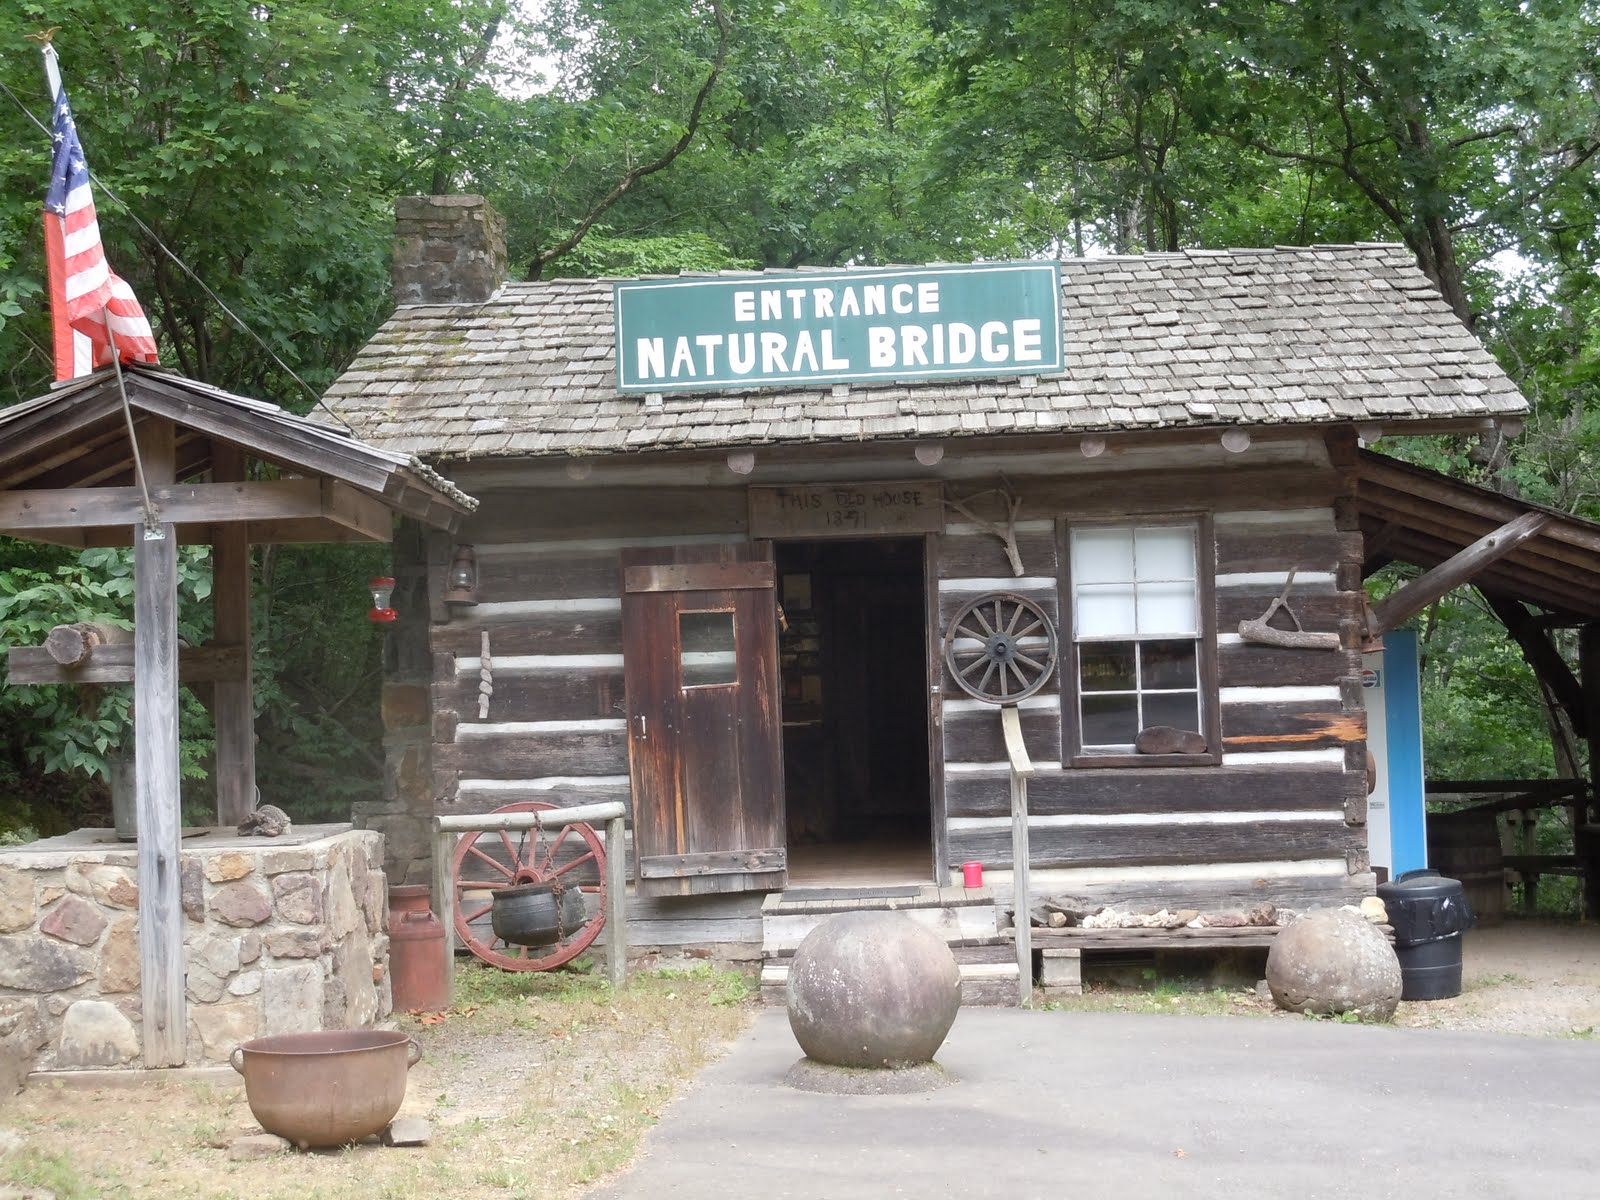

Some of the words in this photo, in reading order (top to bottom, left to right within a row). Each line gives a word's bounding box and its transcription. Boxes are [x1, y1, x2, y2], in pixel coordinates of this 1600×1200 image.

[734, 282, 940, 322] ENTRANCE
[636, 329, 850, 379] NATURAL
[867, 318, 1042, 369] BRIDGE
[778, 492, 822, 510] THIS
[872, 491, 924, 508] HOUSE
